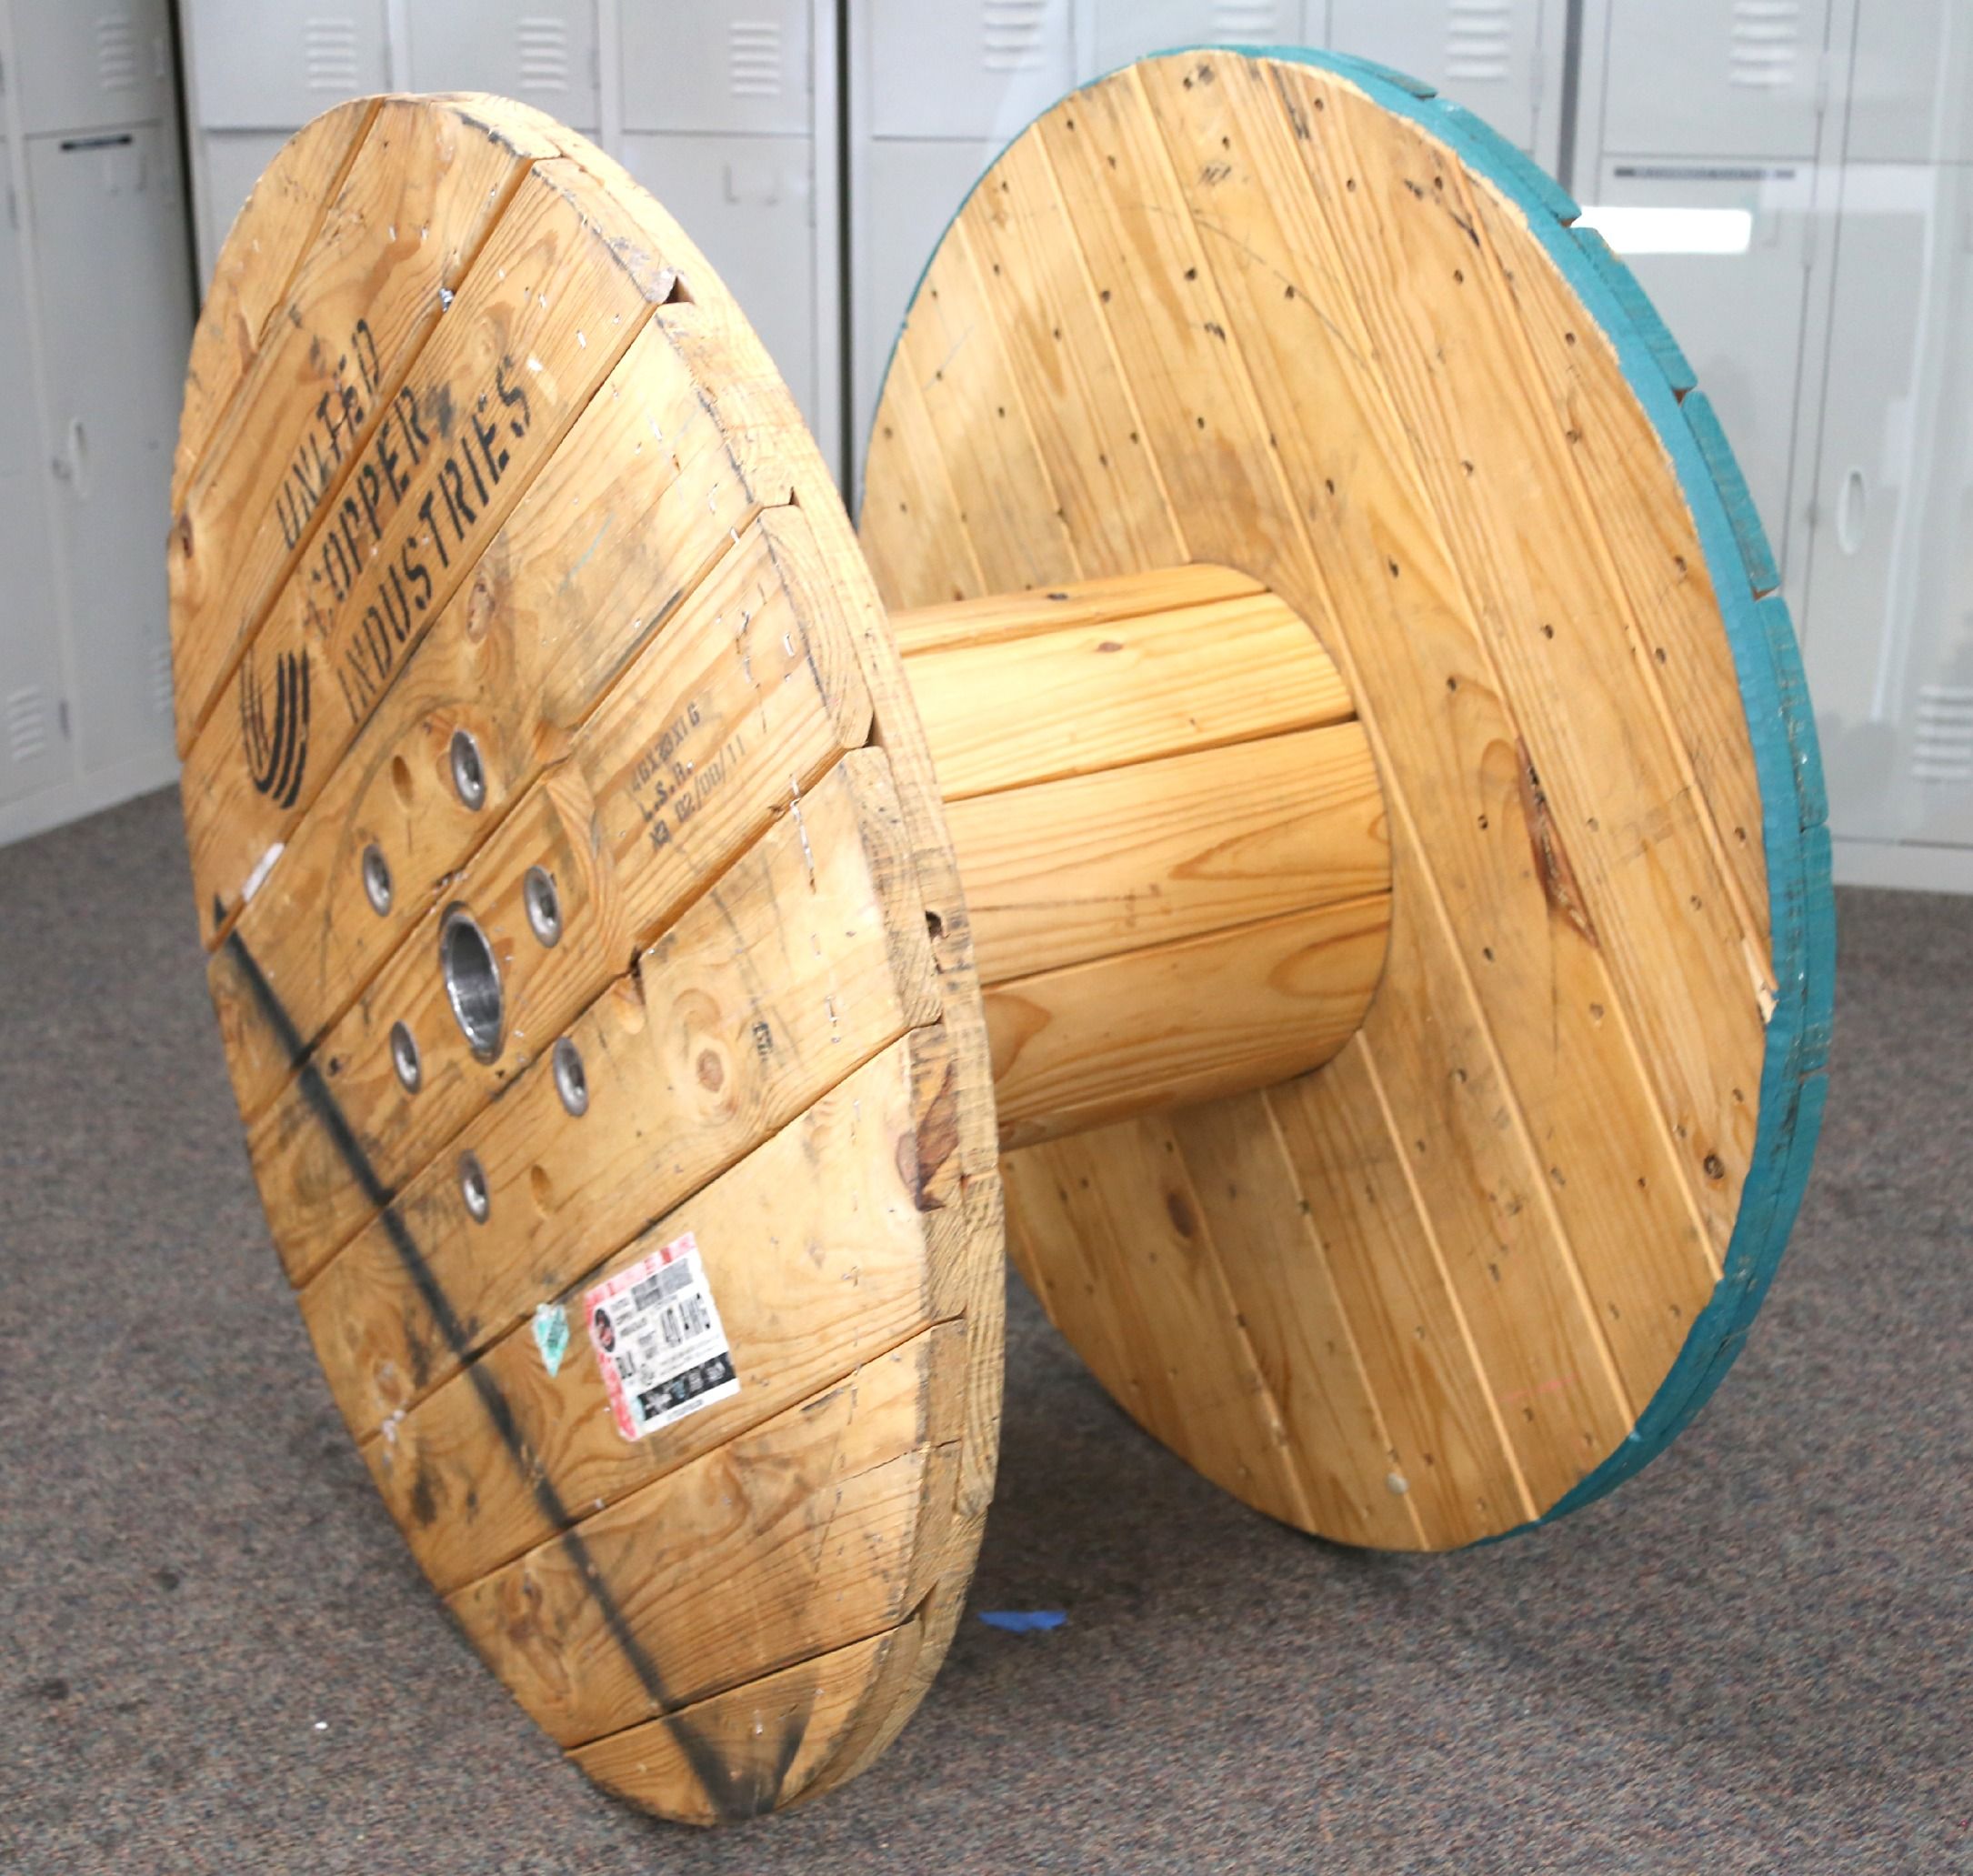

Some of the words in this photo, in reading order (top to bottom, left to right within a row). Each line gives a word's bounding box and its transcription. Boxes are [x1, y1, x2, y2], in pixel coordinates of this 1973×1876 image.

[276, 318, 380, 551] UNITED
[302, 385, 430, 639] COPPER
[337, 354, 531, 725] INDUSTRIES
